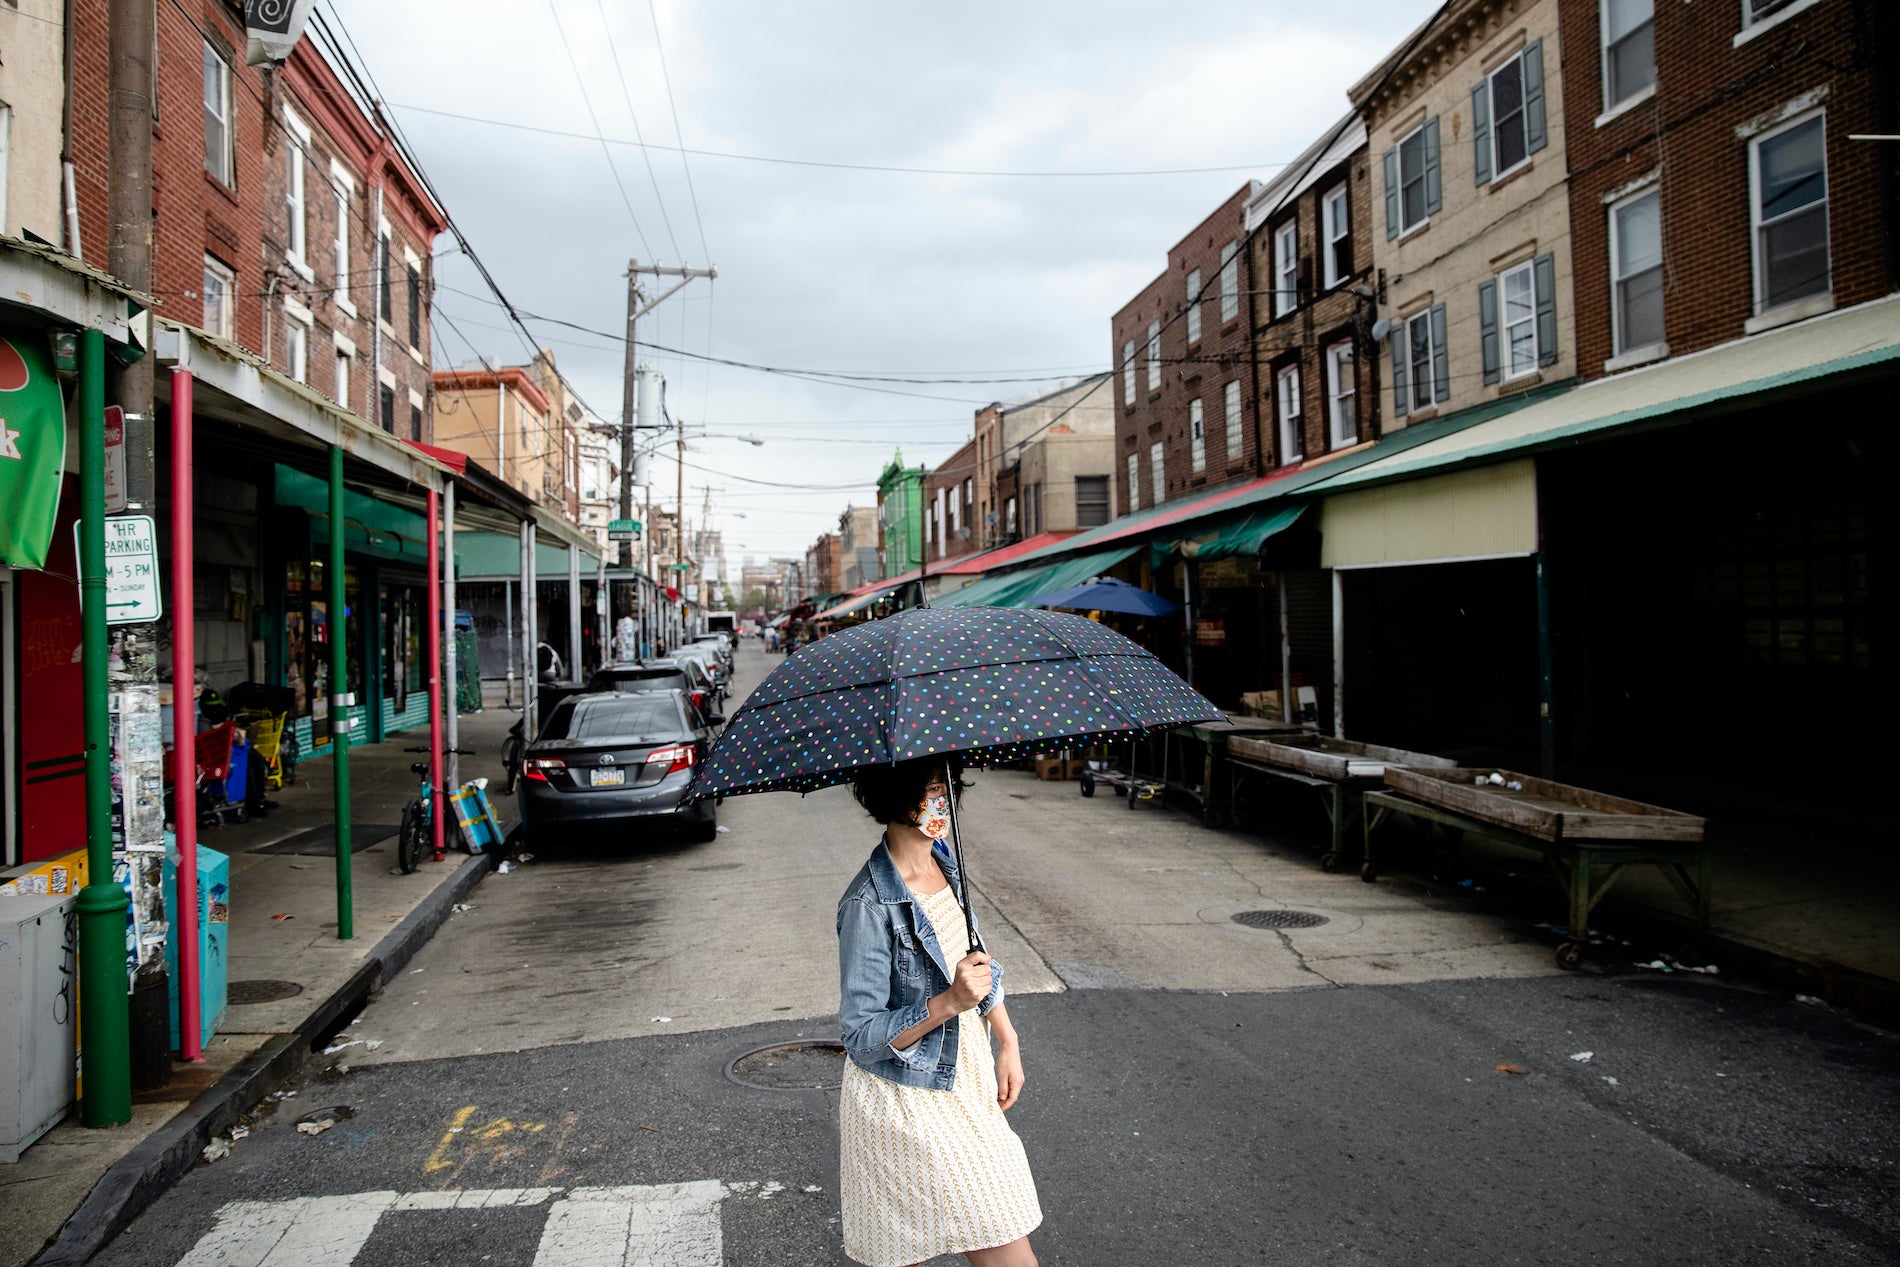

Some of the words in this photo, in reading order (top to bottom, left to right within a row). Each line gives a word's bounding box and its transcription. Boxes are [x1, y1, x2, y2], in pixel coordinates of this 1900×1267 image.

[117, 523, 136, 536] HR
[106, 566, 114, 578] M
[125, 565, 131, 578] 5
[135, 564, 151, 576] PM
[120, 583, 146, 592] SUNDAY
